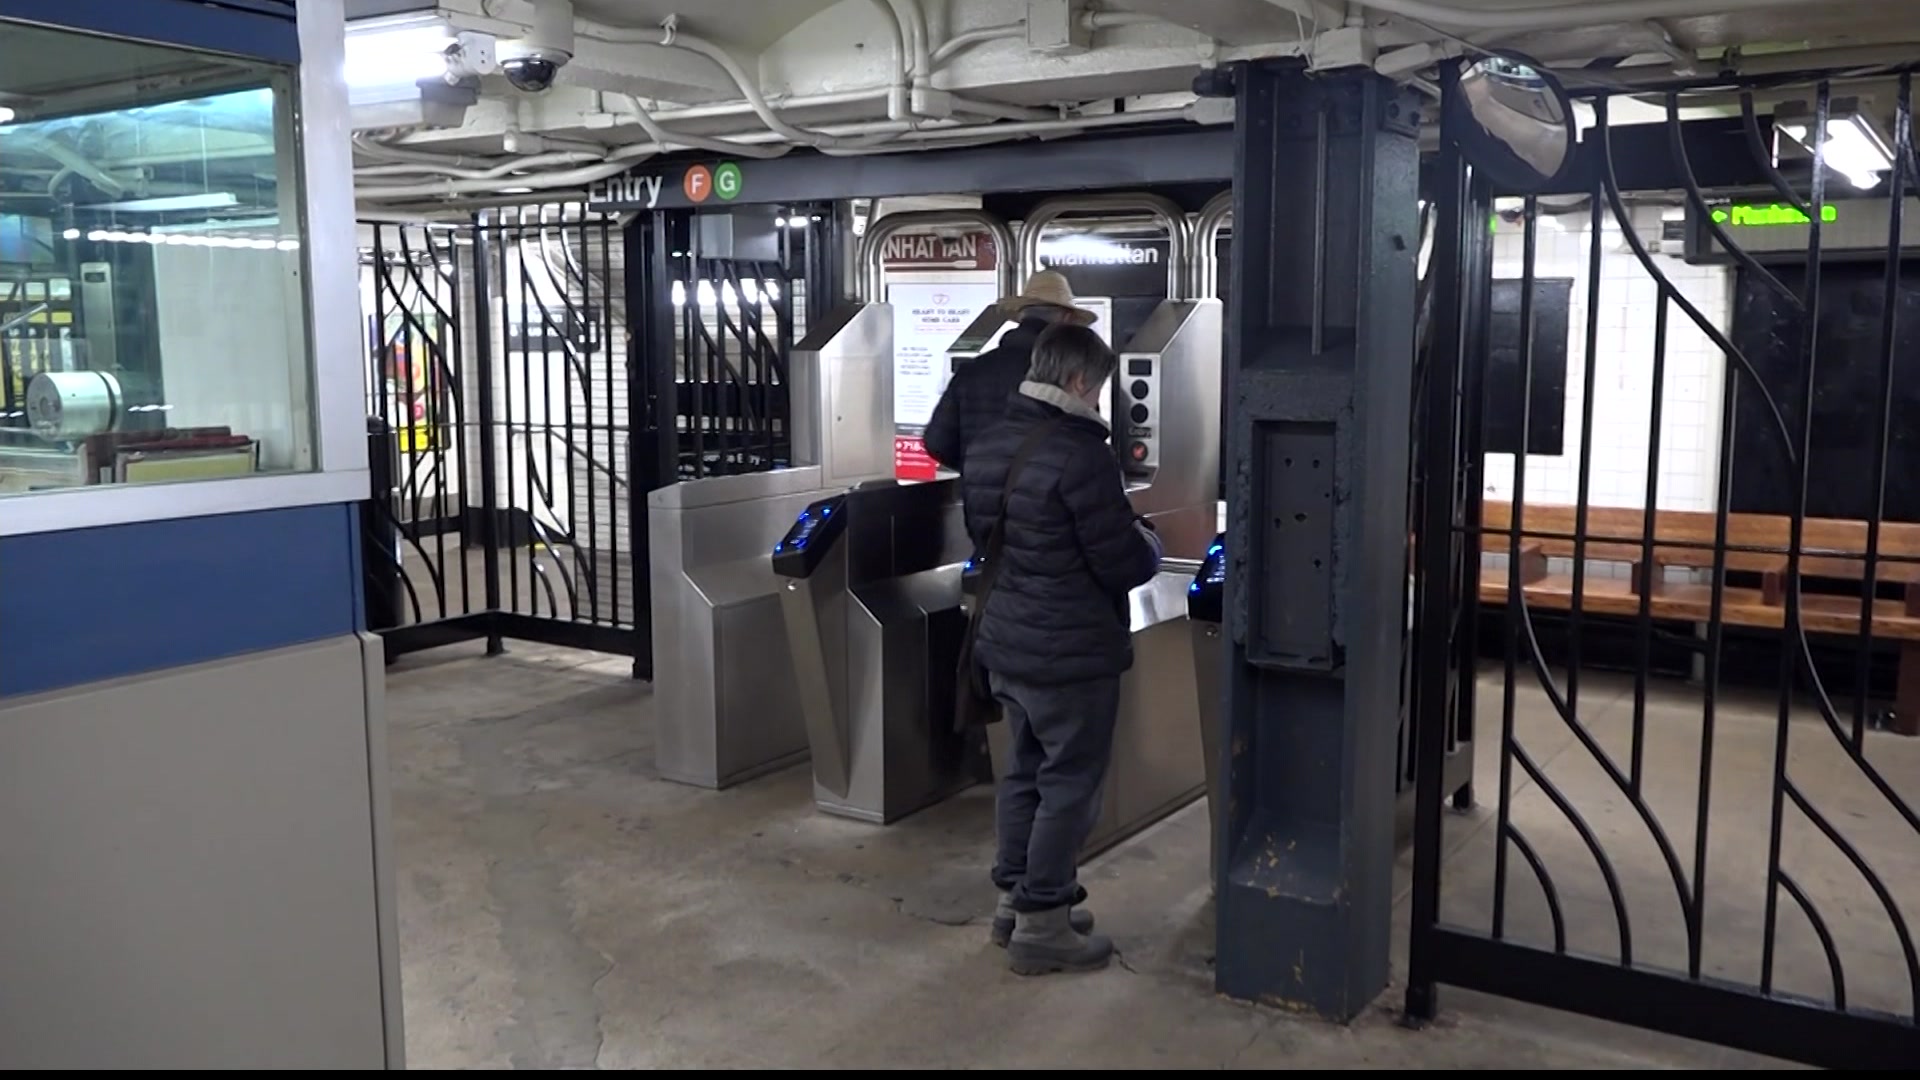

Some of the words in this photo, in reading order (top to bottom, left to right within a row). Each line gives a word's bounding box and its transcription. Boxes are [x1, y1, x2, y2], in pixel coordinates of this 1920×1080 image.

[588, 171, 663, 208] Entry
[691, 174, 704, 194] F
[719, 171, 736, 192] G
